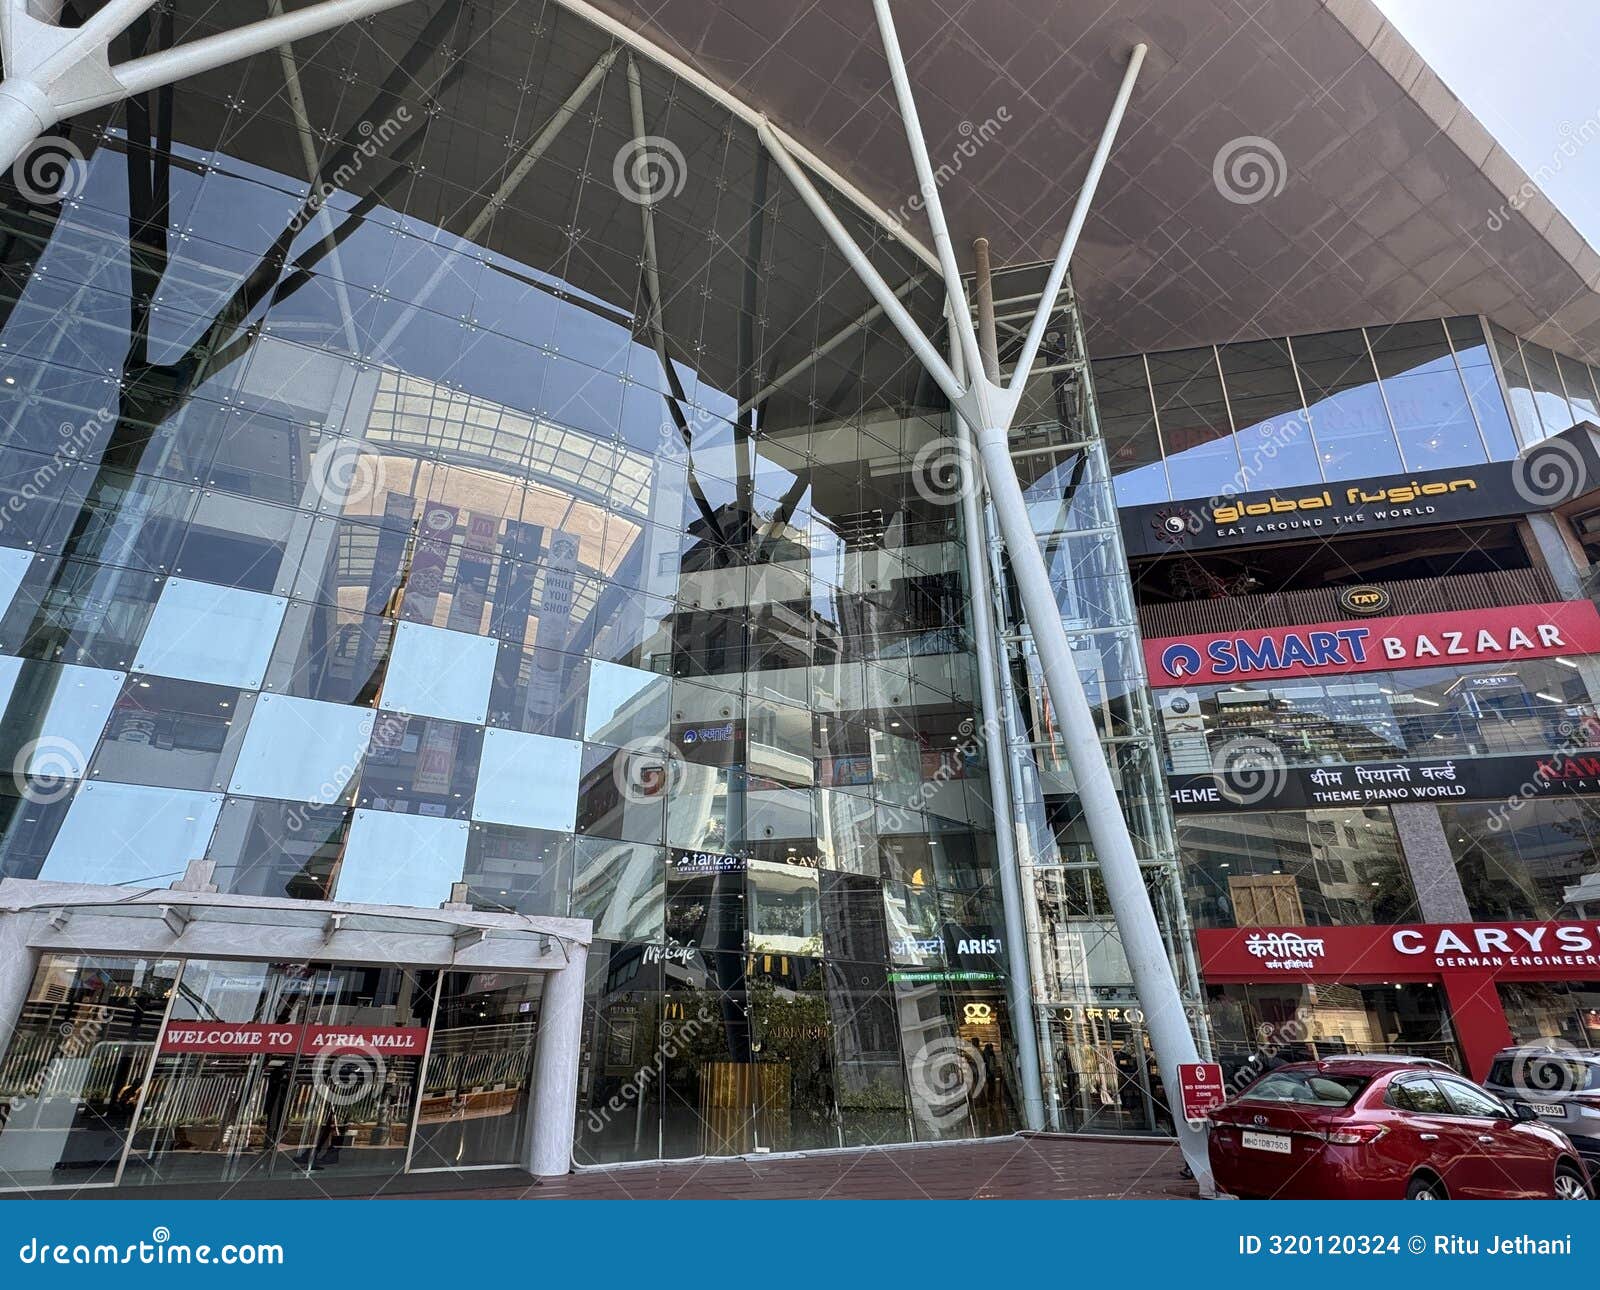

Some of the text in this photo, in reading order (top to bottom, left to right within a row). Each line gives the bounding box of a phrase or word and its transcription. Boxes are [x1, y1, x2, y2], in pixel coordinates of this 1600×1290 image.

[1213, 479, 1477, 524] global fusion
[1217, 506, 1436, 537] EAT AROUND THE WORLD
[549, 590, 568, 602] YOU
[544, 602, 569, 614] SHOP
[1210, 623, 1567, 675] SMART BAZAAR
[1310, 761, 1457, 787] थीम पियानो वर्ल्ड
[1170, 788, 1220, 803] HEME
[1313, 785, 1466, 802] THEME PIANO WORLD
[1392, 926, 1600, 955] CARYS
[1436, 954, 1600, 967] GERMAN ENGINEER
[167, 1030, 293, 1046] WELCOME TO
[311, 1033, 415, 1048] ATRIA MALL
